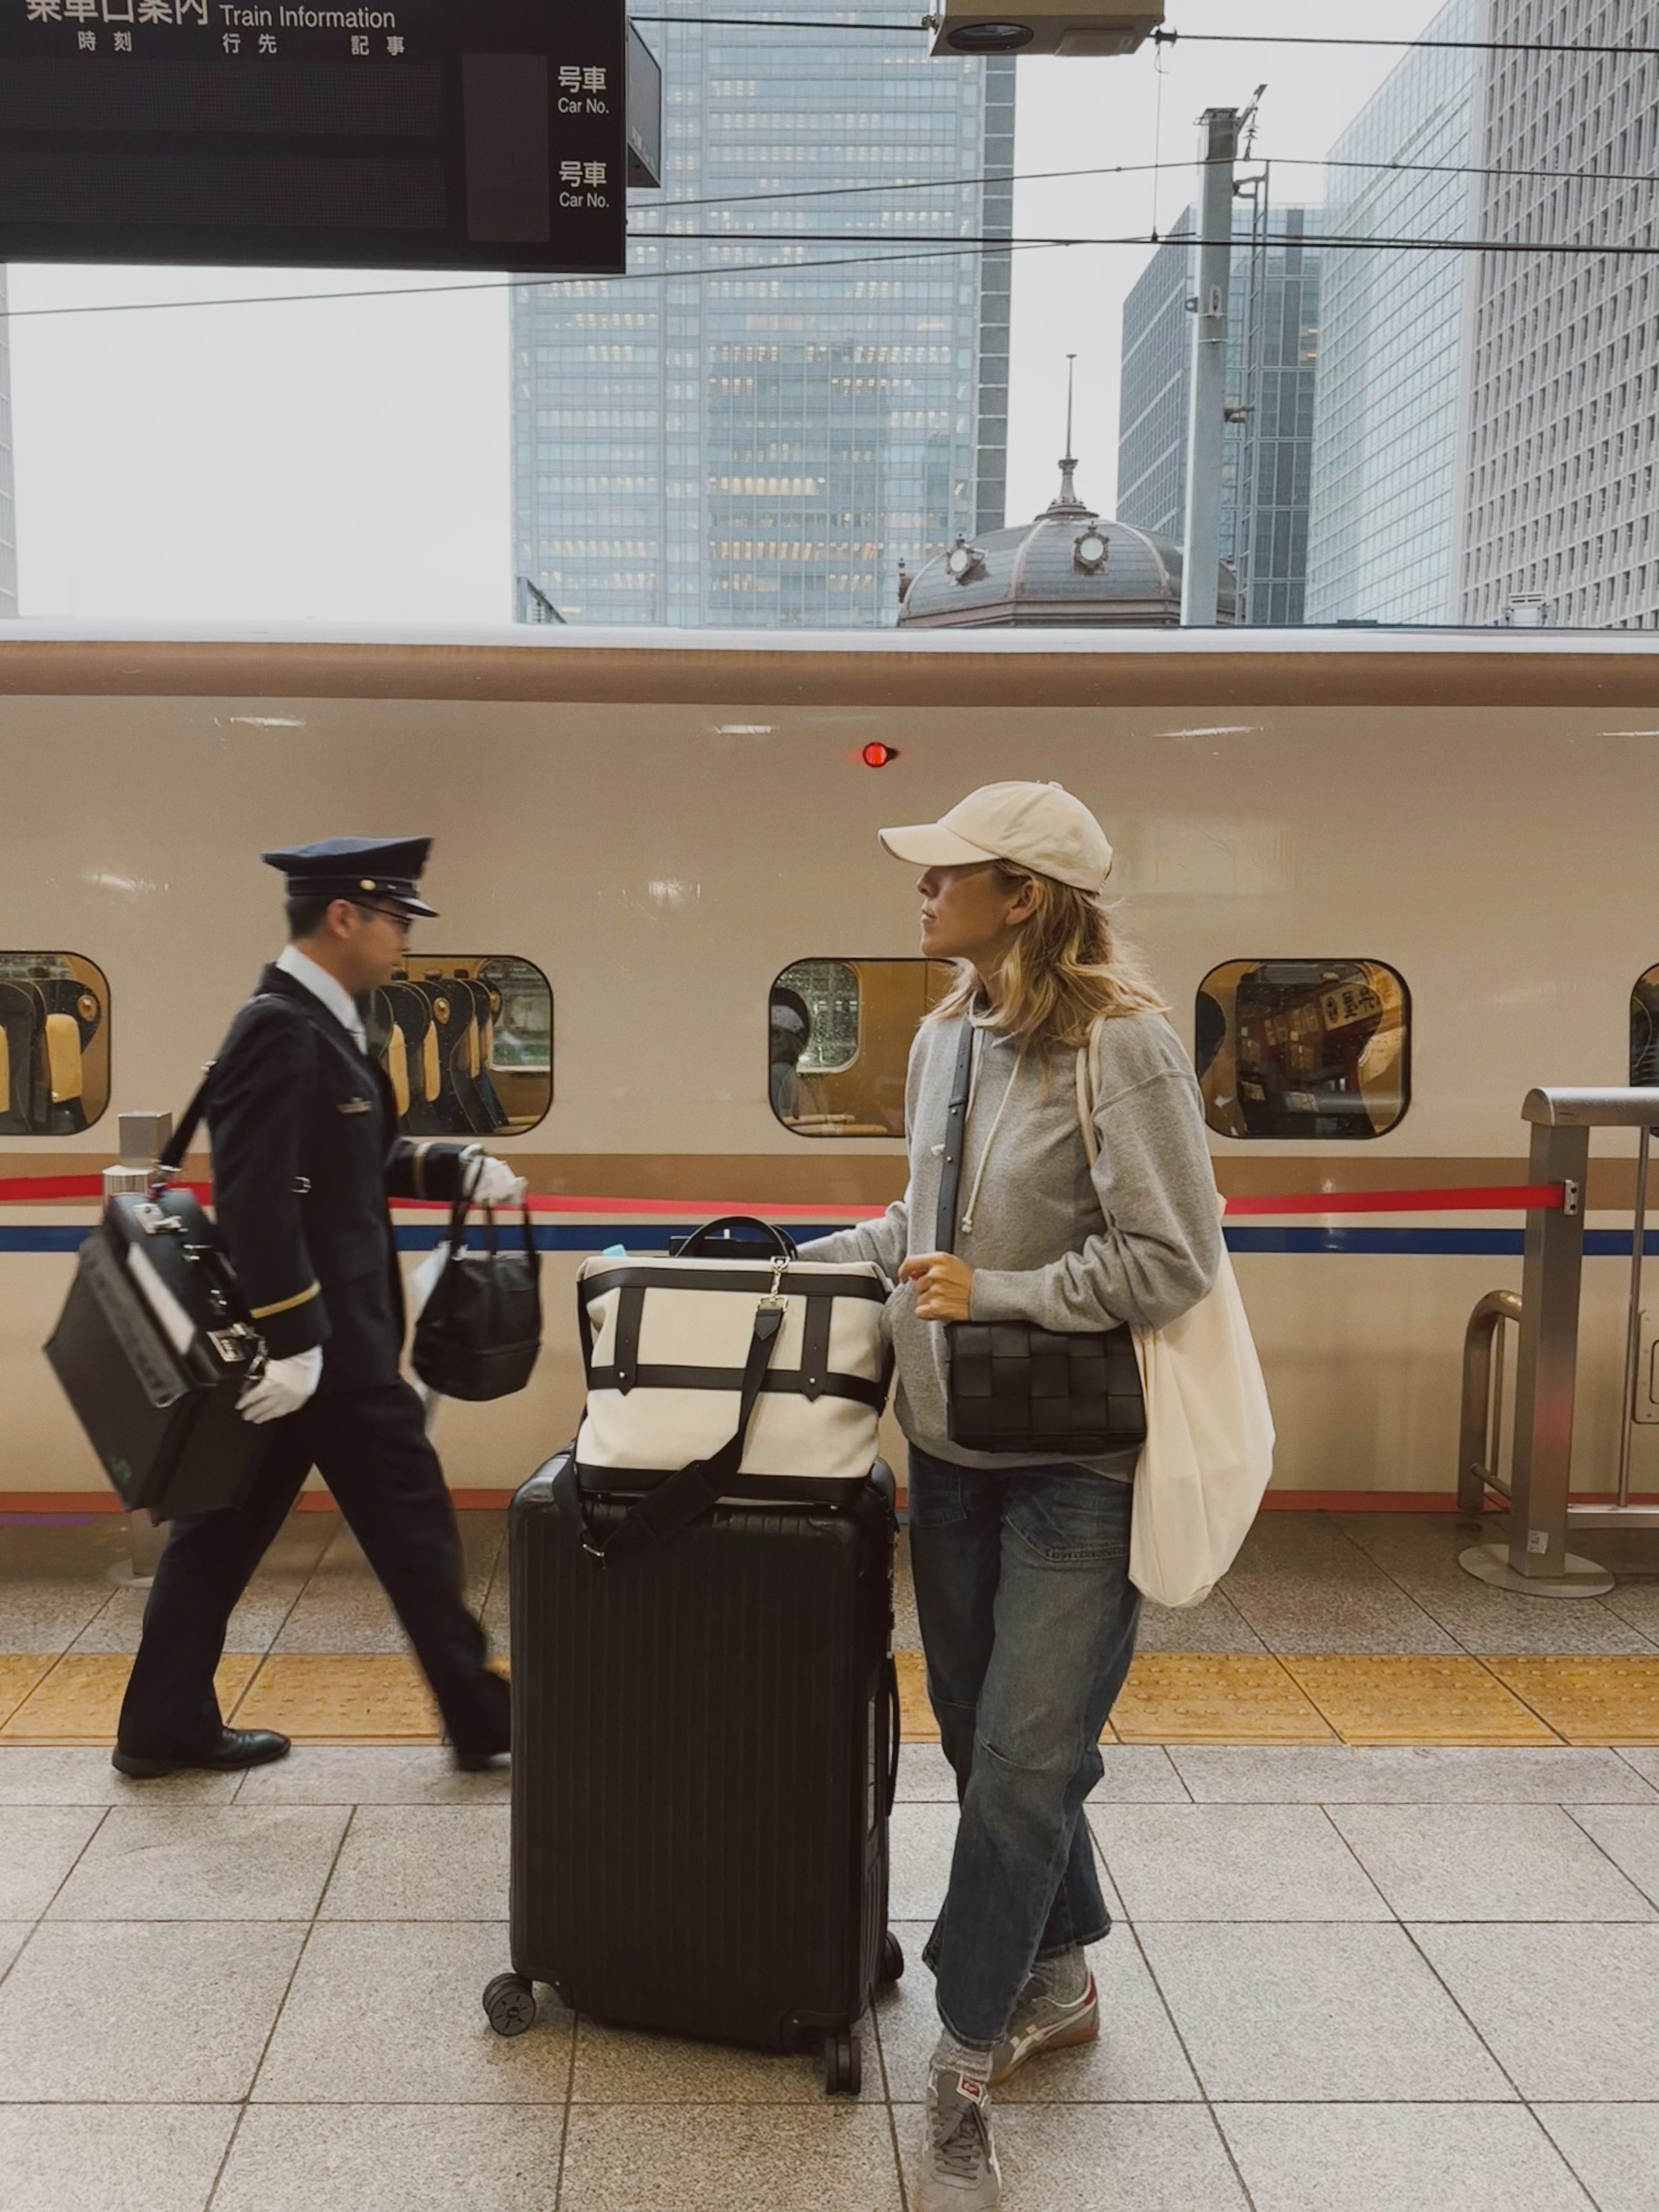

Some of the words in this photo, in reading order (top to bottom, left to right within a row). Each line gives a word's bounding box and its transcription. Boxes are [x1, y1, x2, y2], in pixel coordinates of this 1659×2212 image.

[219, 5, 272, 26] Train
[279, 5, 395, 28] Information
[558, 65, 606, 94] 号車
[558, 97, 582, 113] Car
[586, 98, 609, 114] No.
[559, 161, 606, 187] 号車
[560, 192, 584, 207] Car
[587, 193, 610, 208] No.
